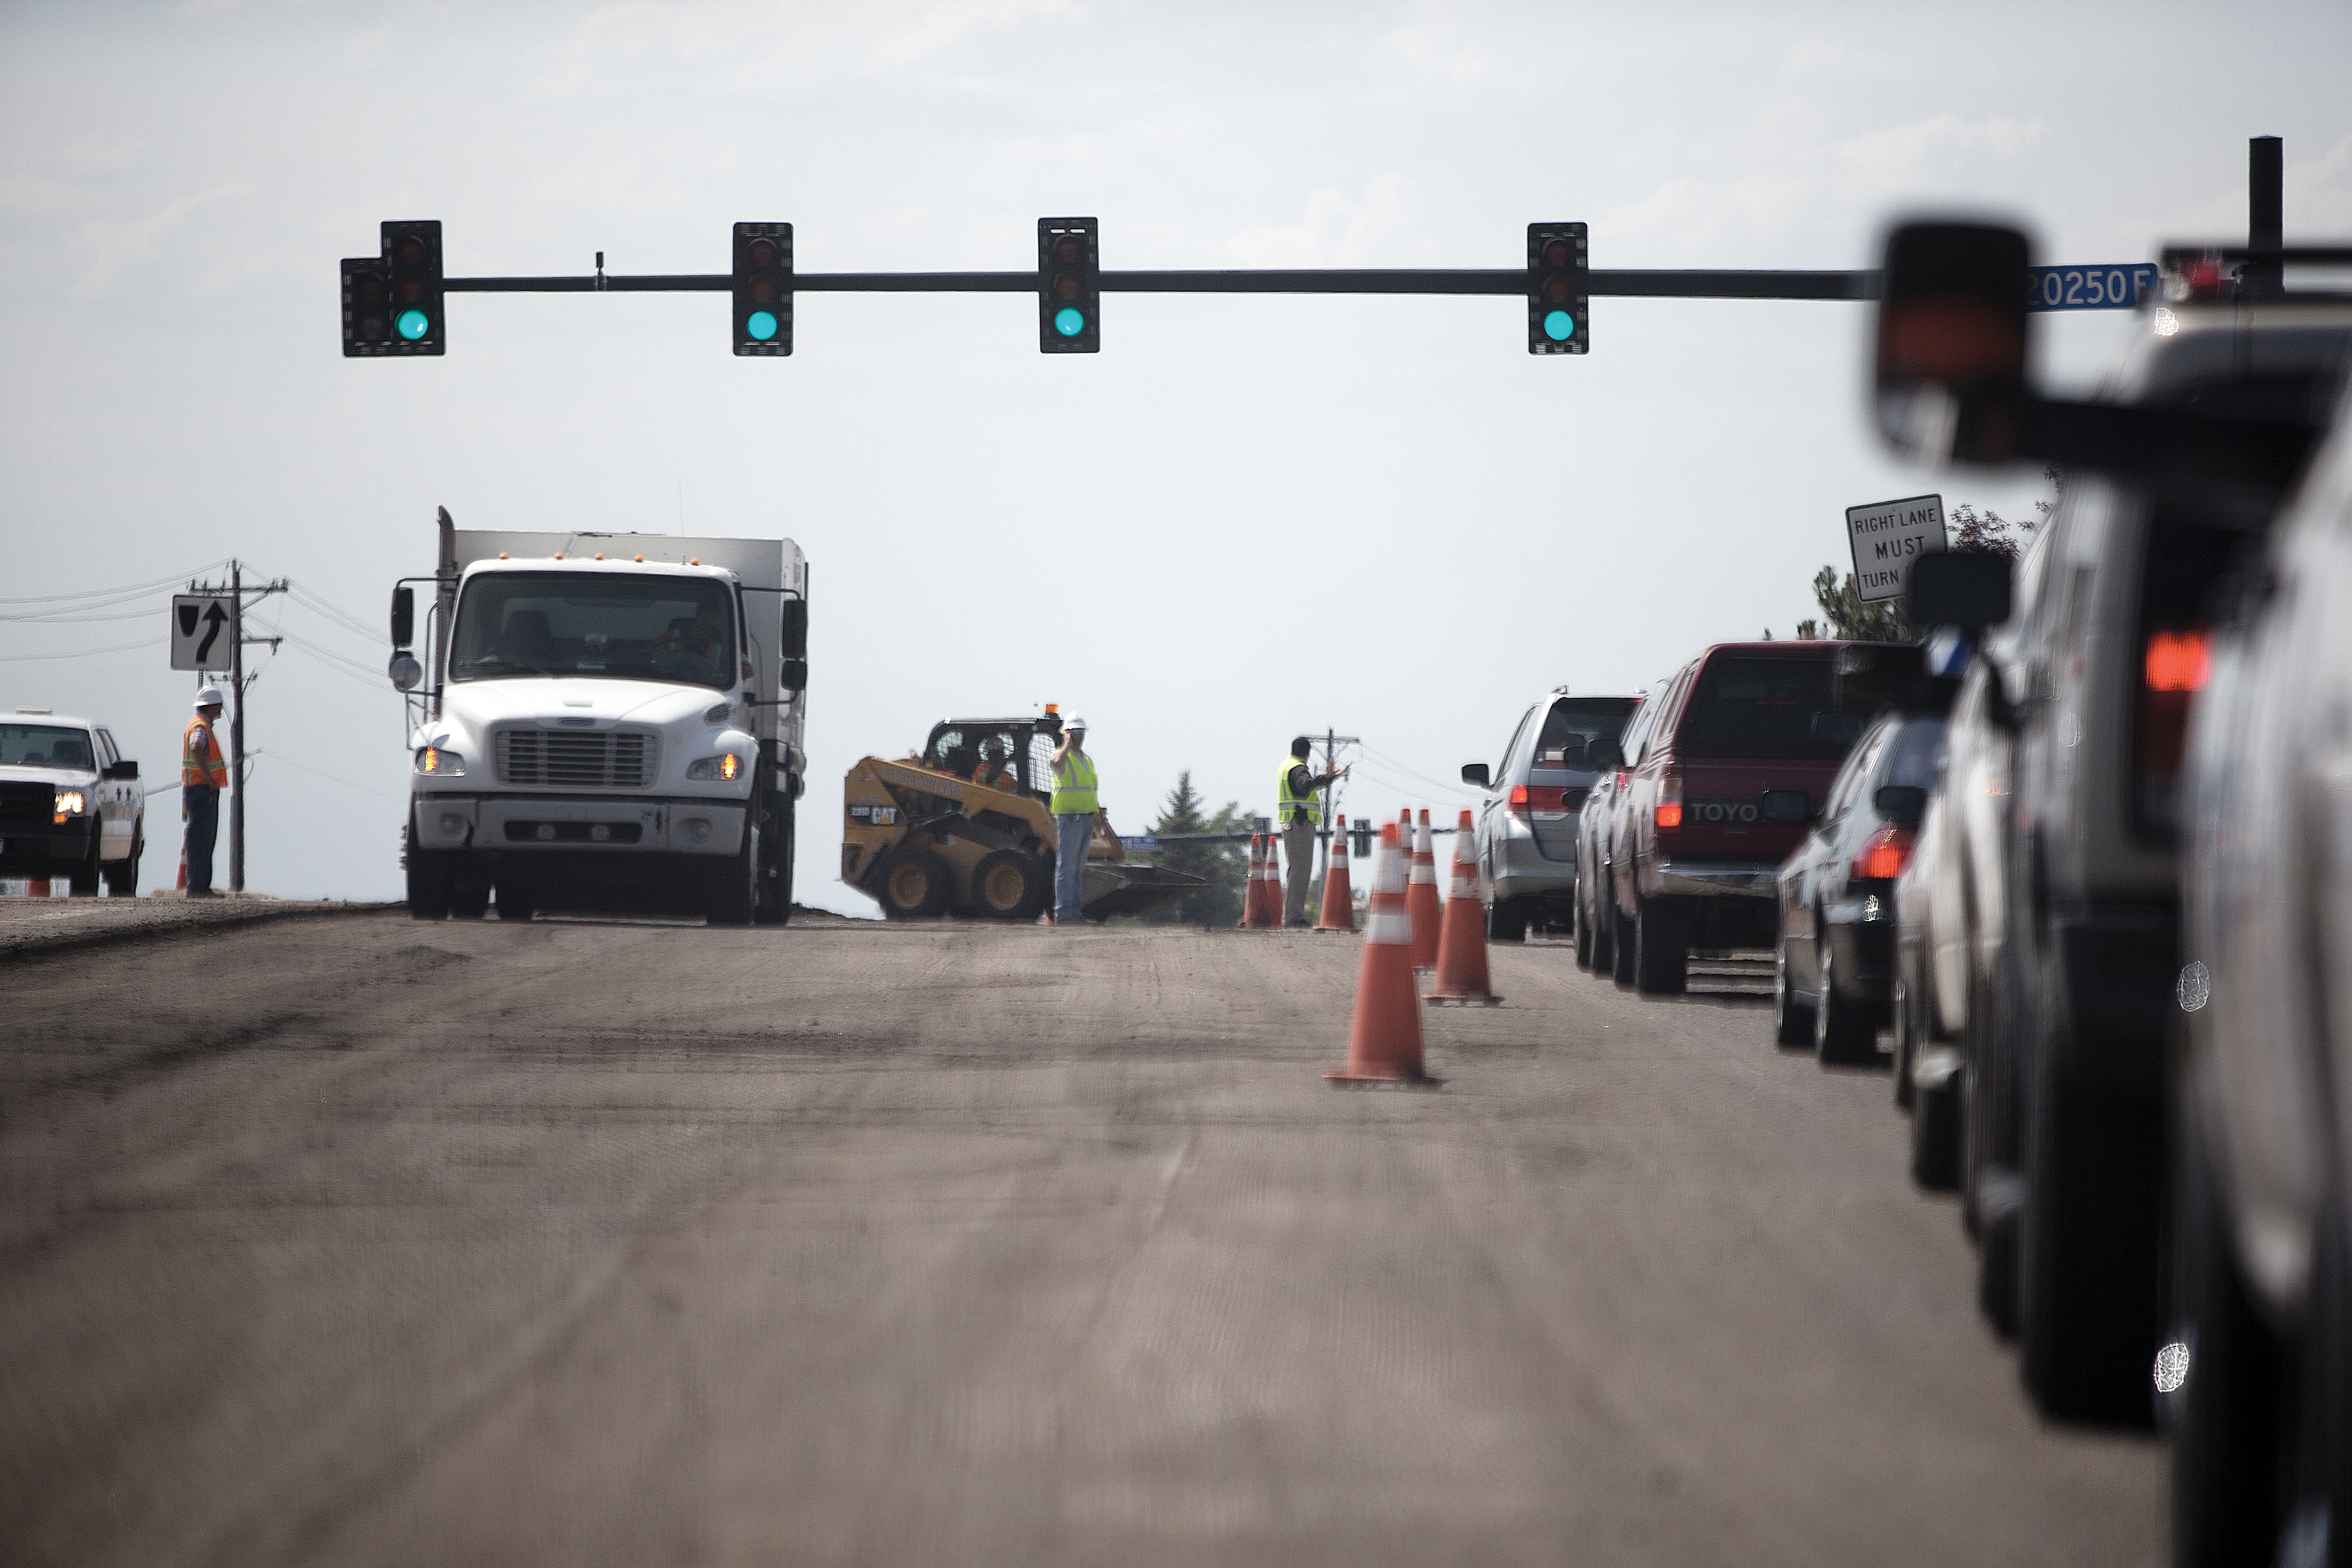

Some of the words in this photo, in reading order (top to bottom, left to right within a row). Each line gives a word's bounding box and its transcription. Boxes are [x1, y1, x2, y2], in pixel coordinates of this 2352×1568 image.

[1855, 515, 1895, 534] RIGHT
[1900, 508, 1936, 527] LANE
[1875, 536, 1925, 560] MUST
[1862, 570, 1899, 588] TURN
[872, 807, 897, 825] CAT
[1690, 803, 1757, 821] TOYO
